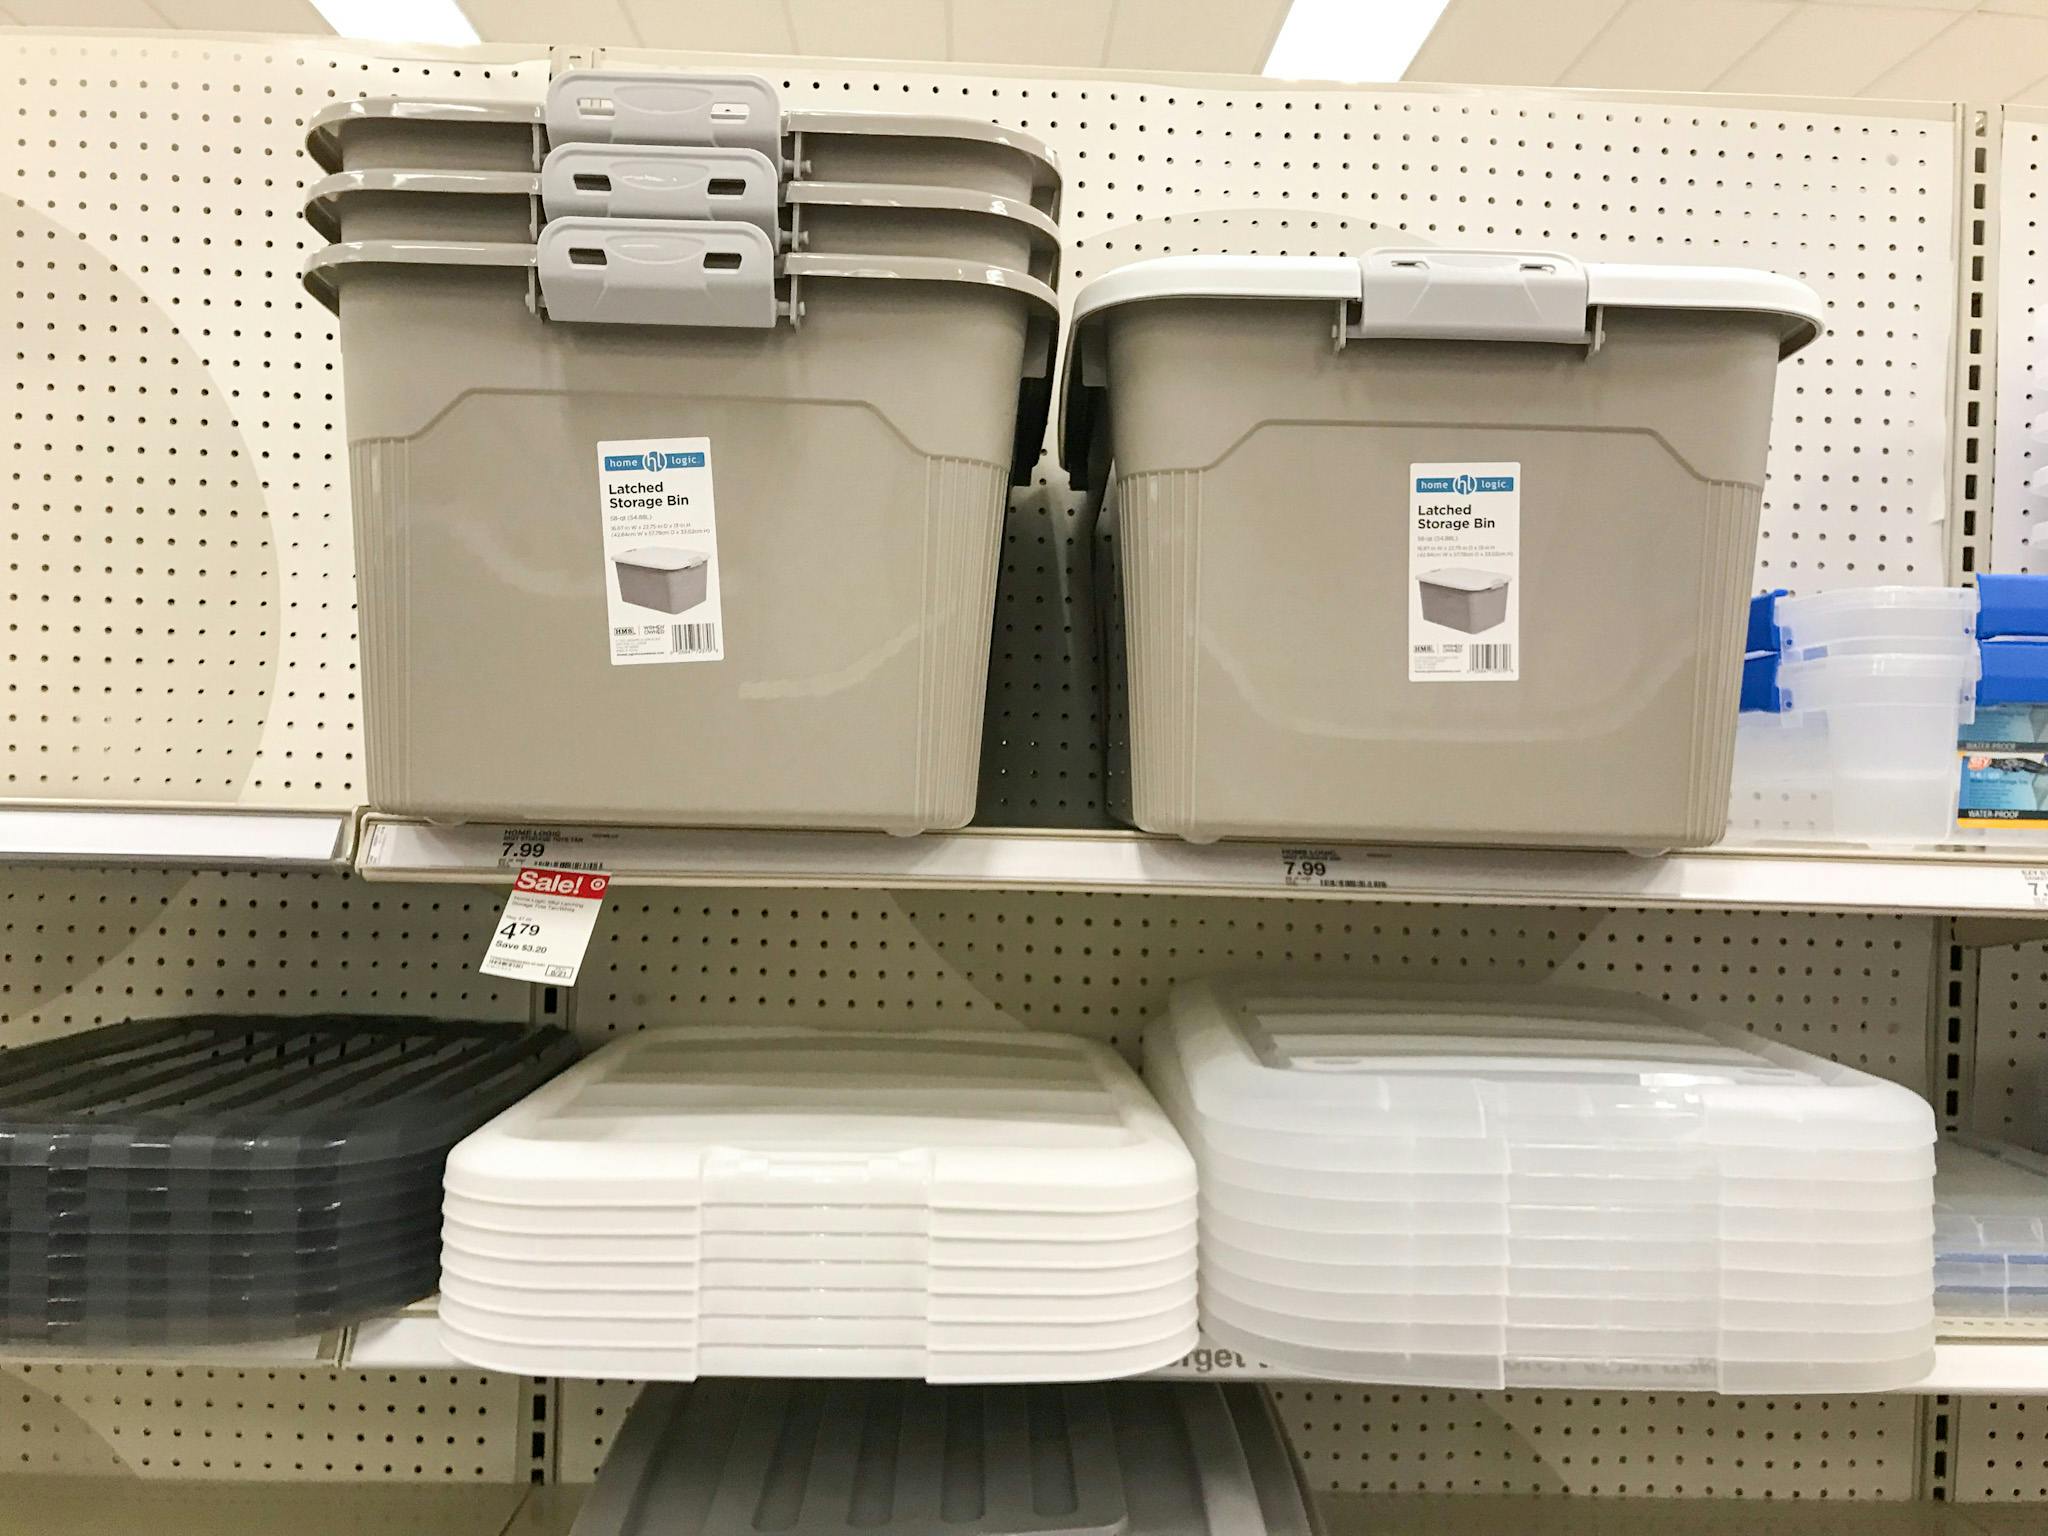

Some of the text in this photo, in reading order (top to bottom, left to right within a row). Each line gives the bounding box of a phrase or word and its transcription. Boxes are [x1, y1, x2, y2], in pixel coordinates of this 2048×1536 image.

[610, 459, 638, 468] home
[671, 456, 697, 466] logic
[608, 481, 664, 495] Latched
[1420, 480, 1448, 489] home
[1481, 479, 1506, 490] logic
[610, 494, 690, 510] Storage Bin
[1418, 505, 1472, 516] Latched
[1418, 518, 1496, 530] Storage Bin
[1968, 810, 2020, 818] WATER-PROOF
[502, 843, 545, 857] 7.99
[1283, 862, 1326, 876] 7.99
[518, 870, 584, 894] Sale!
[496, 940, 547, 954] Save $3.20
